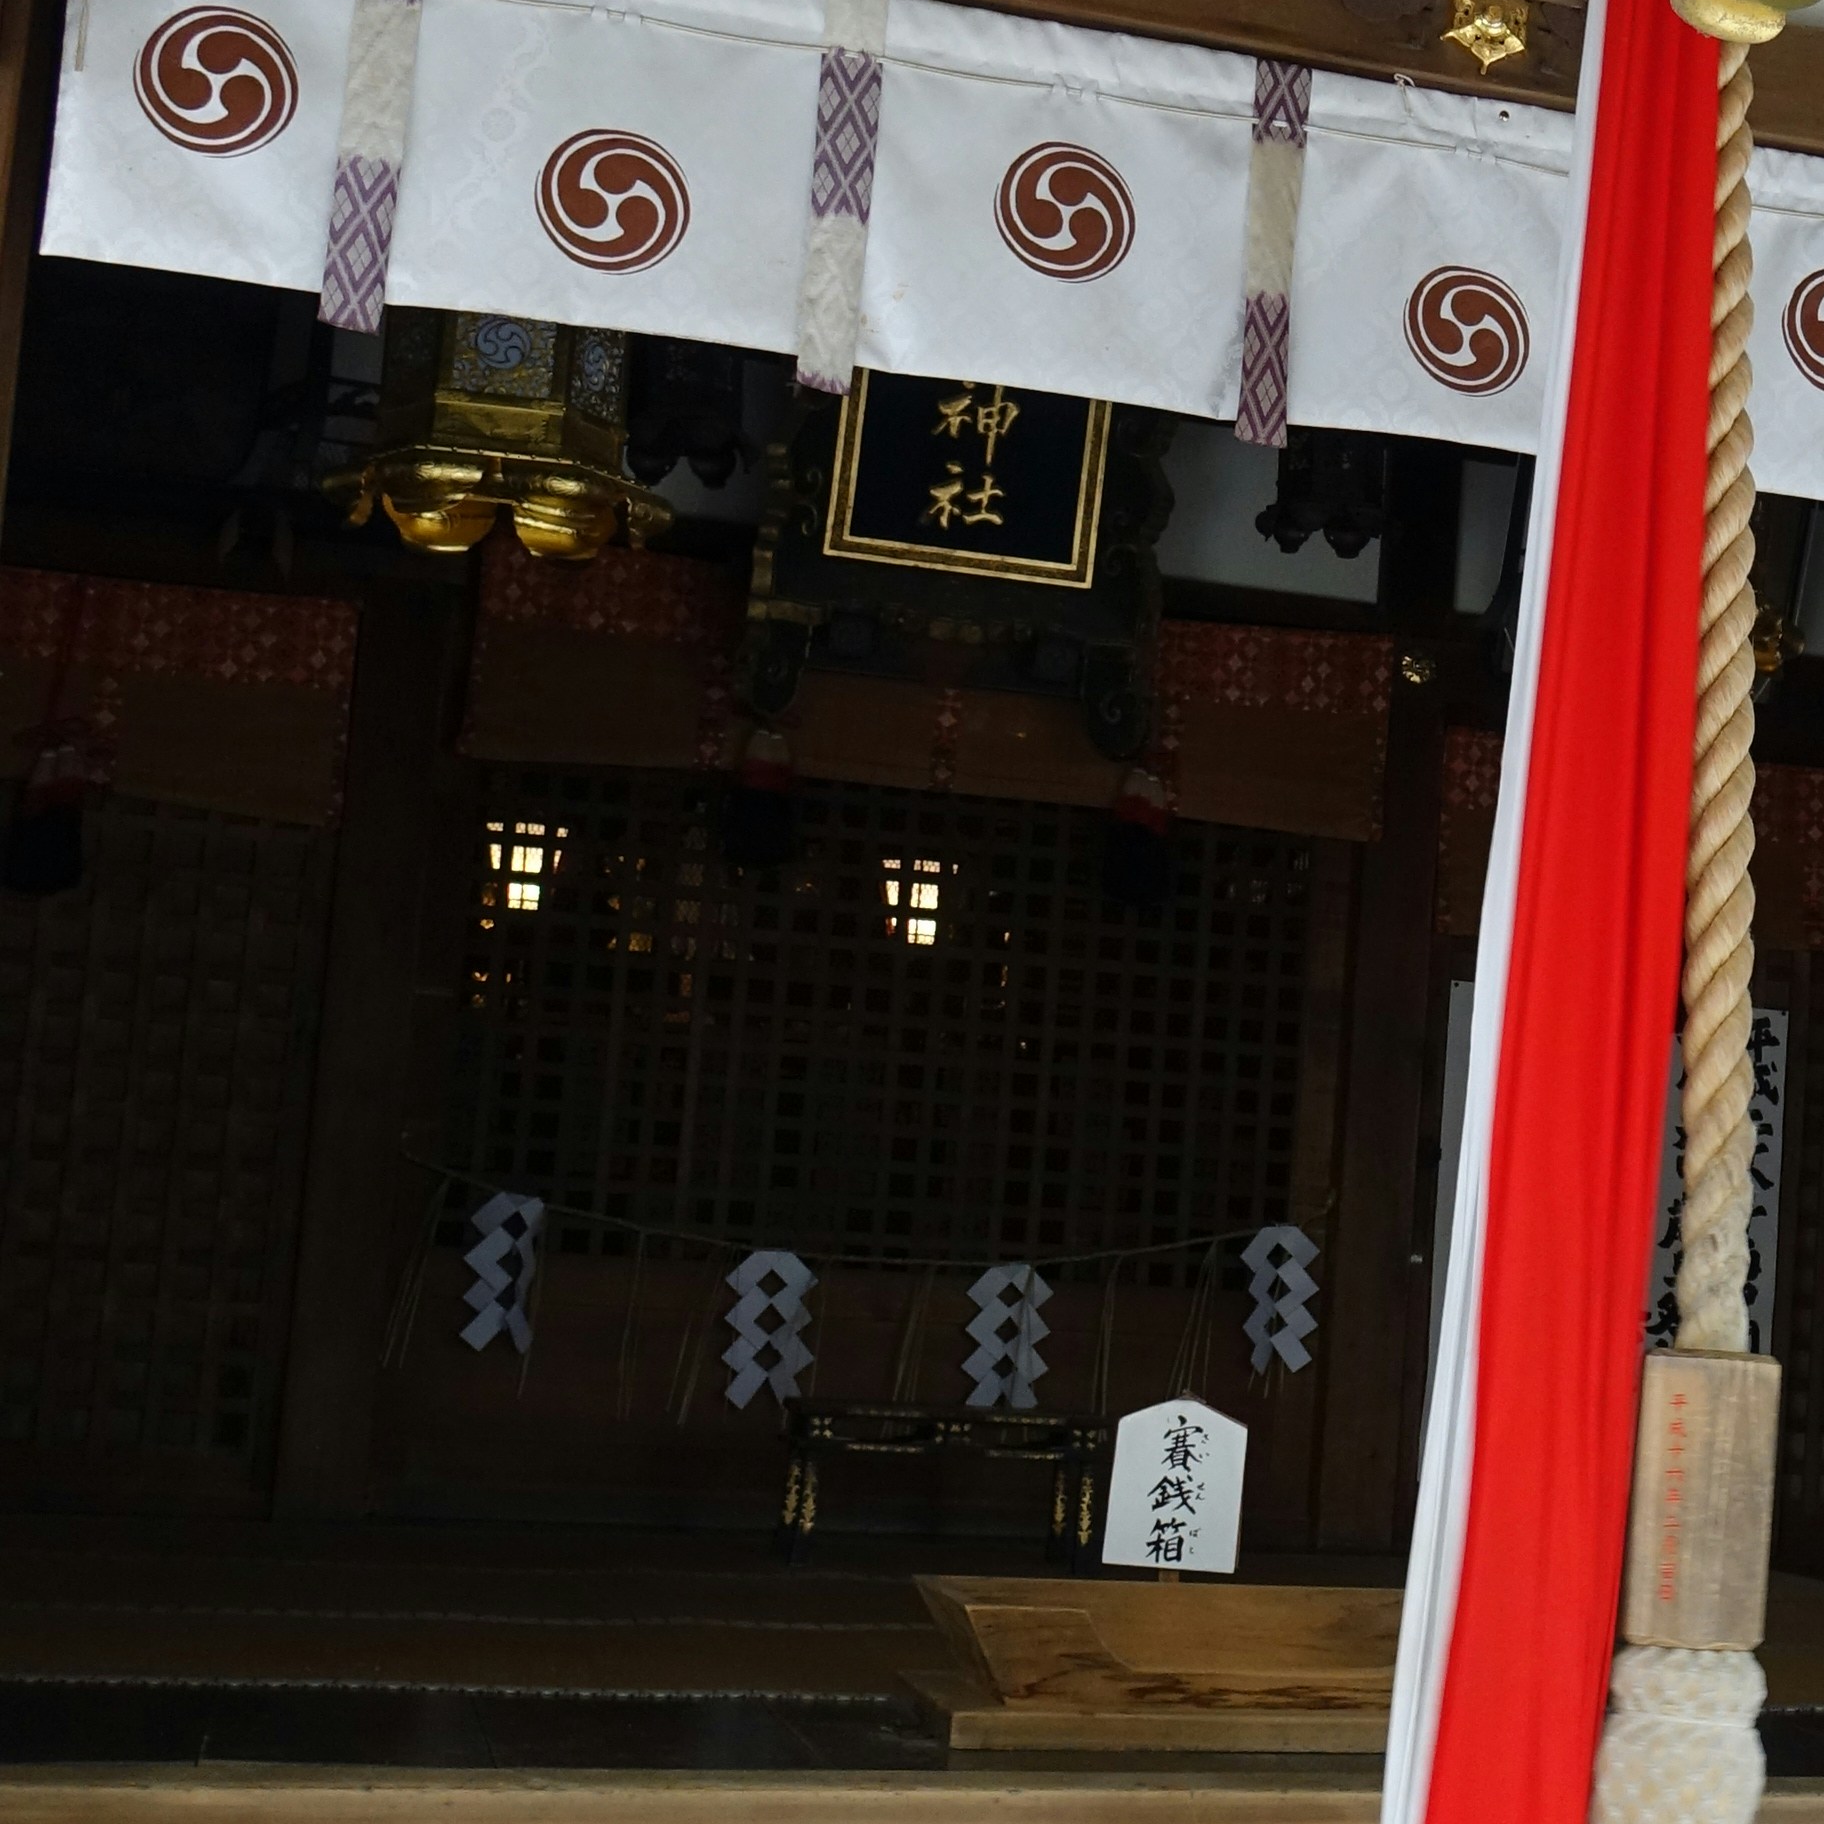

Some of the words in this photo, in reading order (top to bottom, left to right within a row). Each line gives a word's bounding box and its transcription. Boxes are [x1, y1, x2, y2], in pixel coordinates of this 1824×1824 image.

[930, 380, 1020, 530] 神社
[1146, 1414, 1204, 1564] 賽銭箱
